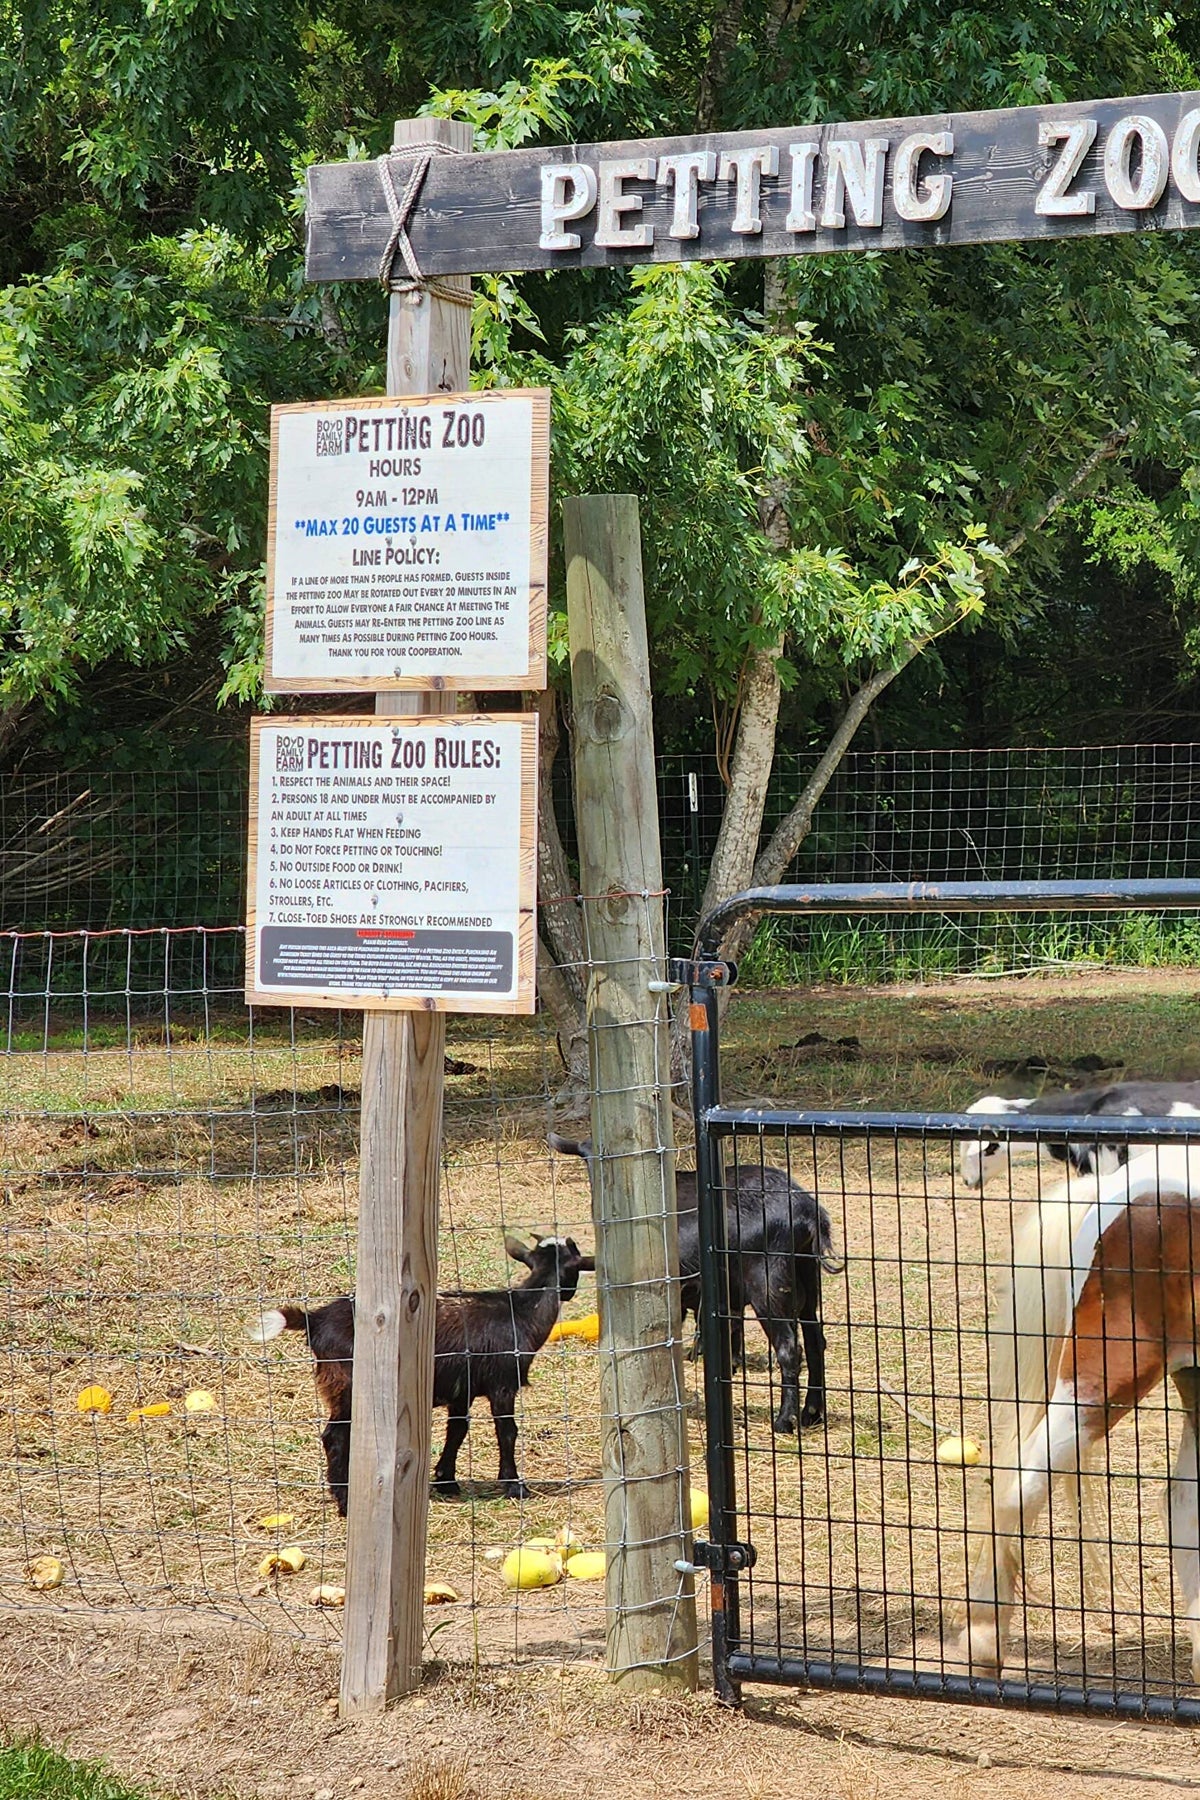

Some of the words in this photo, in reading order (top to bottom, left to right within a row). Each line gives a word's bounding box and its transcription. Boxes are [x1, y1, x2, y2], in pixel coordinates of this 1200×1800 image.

[538, 131, 954, 251] PETTING
[317, 419, 342, 431] BOYD
[344, 415, 430, 452] PETTING
[442, 410, 484, 448] ZOO
[316, 431, 342, 441] FAMILY
[316, 440, 342, 454] FARM
[370, 457, 420, 477] HOURS
[356, 489, 386, 507] 9AM
[402, 486, 438, 505] 12PM
[342, 517, 359, 535] 20
[363, 515, 416, 534] GUESTS
[420, 514, 440, 532] AT
[444, 513, 456, 531] A
[352, 548, 380, 565] LINE
[385, 547, 439, 565] POLICY:
[291, 576, 297, 585] IF
[298, 577, 303, 585] A
[305, 576, 318, 585] LINE
[319, 576, 328, 584] OF
[330, 575, 348, 584] MORE
[350, 575, 369, 583] THAN
[371, 574, 375, 583] 5
[377, 574, 401, 583] PEOPLE
[403, 573, 419, 582] HAS
[421, 573, 452, 581] FORMED.
[455, 571, 483, 581] GUESTS
[486, 571, 510, 580] INSIDE
[286, 592, 297, 600] THE
[299, 591, 325, 599] PETTING
[327, 590, 341, 599] ZOO
[343, 589, 359, 598] MAY
[361, 590, 368, 598] BE
[370, 588, 400, 597] ROTATED
[402, 588, 418, 597] OUT
[420, 587, 443, 596] EVERY
[445, 587, 455, 596] 20
[457, 586, 491, 596] MINUTES
[493, 586, 501, 595] IN
[504, 586, 516, 595] AN
[291, 605, 313, 614] EFFORT
[315, 604, 324, 614] TO
[325, 604, 348, 613] ALLOW
[351, 603, 386, 612] EVERYONE
[395, 603, 411, 611] FAIR
[414, 602, 444, 611] CHANCE
[446, 602, 456, 611] AT
[458, 601, 492, 611] MEETING
[494, 601, 509, 610] THE
[327, 618, 352, 627] GUESTS
[355, 619, 370, 627] MAY
[372, 617, 405, 627] RE-ENTER
[407, 618, 420, 626] THE
[423, 616, 453, 626] PETTING
[456, 616, 473, 625] ZOO
[475, 616, 491, 625] LINE
[494, 617, 504, 625] AS
[299, 634, 319, 642] MANY
[321, 633, 340, 642] TIMES
[342, 633, 351, 642] AS
[353, 632, 384, 642] POSSIBLE
[386, 632, 414, 641] DURING
[416, 631, 447, 641] PETTING
[449, 631, 467, 640] ZOO
[469, 631, 497, 640] HOURS.
[328, 647, 352, 656] THANK
[354, 648, 368, 656] YOU
[371, 648, 384, 656] FOR
[386, 647, 406, 656] YOUR
[408, 646, 462, 656] COOPERATION.
[276, 735, 304, 748] BOYD
[276, 748, 303, 758] FAMILY
[308, 738, 382, 768] PETTING
[391, 737, 425, 768] ZOO
[434, 737, 500, 768] RULES:
[276, 757, 303, 768] FARM
[272, 776, 277, 786] 1.
[280, 776, 313, 786] RESPECT
[315, 777, 330, 786] THE
[332, 776, 371, 786] ANIMALS
[374, 777, 392, 786] AND
[395, 776, 418, 786] THEIR
[421, 776, 450, 786] SPACE!
[271, 793, 279, 803] 2.
[281, 793, 317, 803] PERSONS
[320, 793, 328, 803] 18
[331, 794, 348, 803] AND
[351, 794, 378, 803] UNDER
[382, 793, 405, 803] MUST
[408, 794, 417, 803] BE
[420, 794, 482, 804] ACCOMPANIED
[485, 794, 495, 803] BY
[271, 811, 283, 820] AN
[285, 811, 311, 820] ADULT
[313, 811, 323, 820] AT
[326, 811, 340, 820] ALL
[343, 811, 366, 820] TIMES
[270, 827, 278, 837] 3.
[280, 827, 300, 837] KEEP
[303, 827, 332, 837] HANDS
[334, 827, 354, 837] FLAT
[356, 828, 383, 838] WHEN
[385, 828, 420, 838] FEEDING
[270, 844, 277, 854] 4.
[280, 844, 292, 854] DO
[295, 844, 312, 854] NOT
[315, 844, 340, 855] FORCE
[343, 845, 377, 855] PETTING
[380, 845, 392, 855] OR
[394, 845, 442, 856] TOUCHING!
[270, 861, 277, 871] 5.
[280, 861, 292, 871] NO
[295, 861, 329, 872] OUTSIDE
[332, 862, 355, 872] FOOD
[358, 863, 369, 872] OR
[372, 862, 402, 873] DRINK!
[269, 879, 277, 888] 6.
[279, 879, 292, 888] NO
[295, 879, 320, 889] LOOSE
[323, 879, 361, 889] ARTICLES
[363, 880, 373, 889] OF
[376, 880, 421, 892] CLOTHING,
[424, 880, 468, 893] PACIFIERS,
[269, 895, 313, 907] STROLLERS,
[316, 896, 332, 906] ETC.
[277, 912, 327, 923] CLOSE-TOED
[330, 913, 356, 924] SHOES
[359, 914, 376, 924] ARE
[379, 914, 423, 925] STRONGLY
[426, 915, 492, 927] RECOMMENDED
